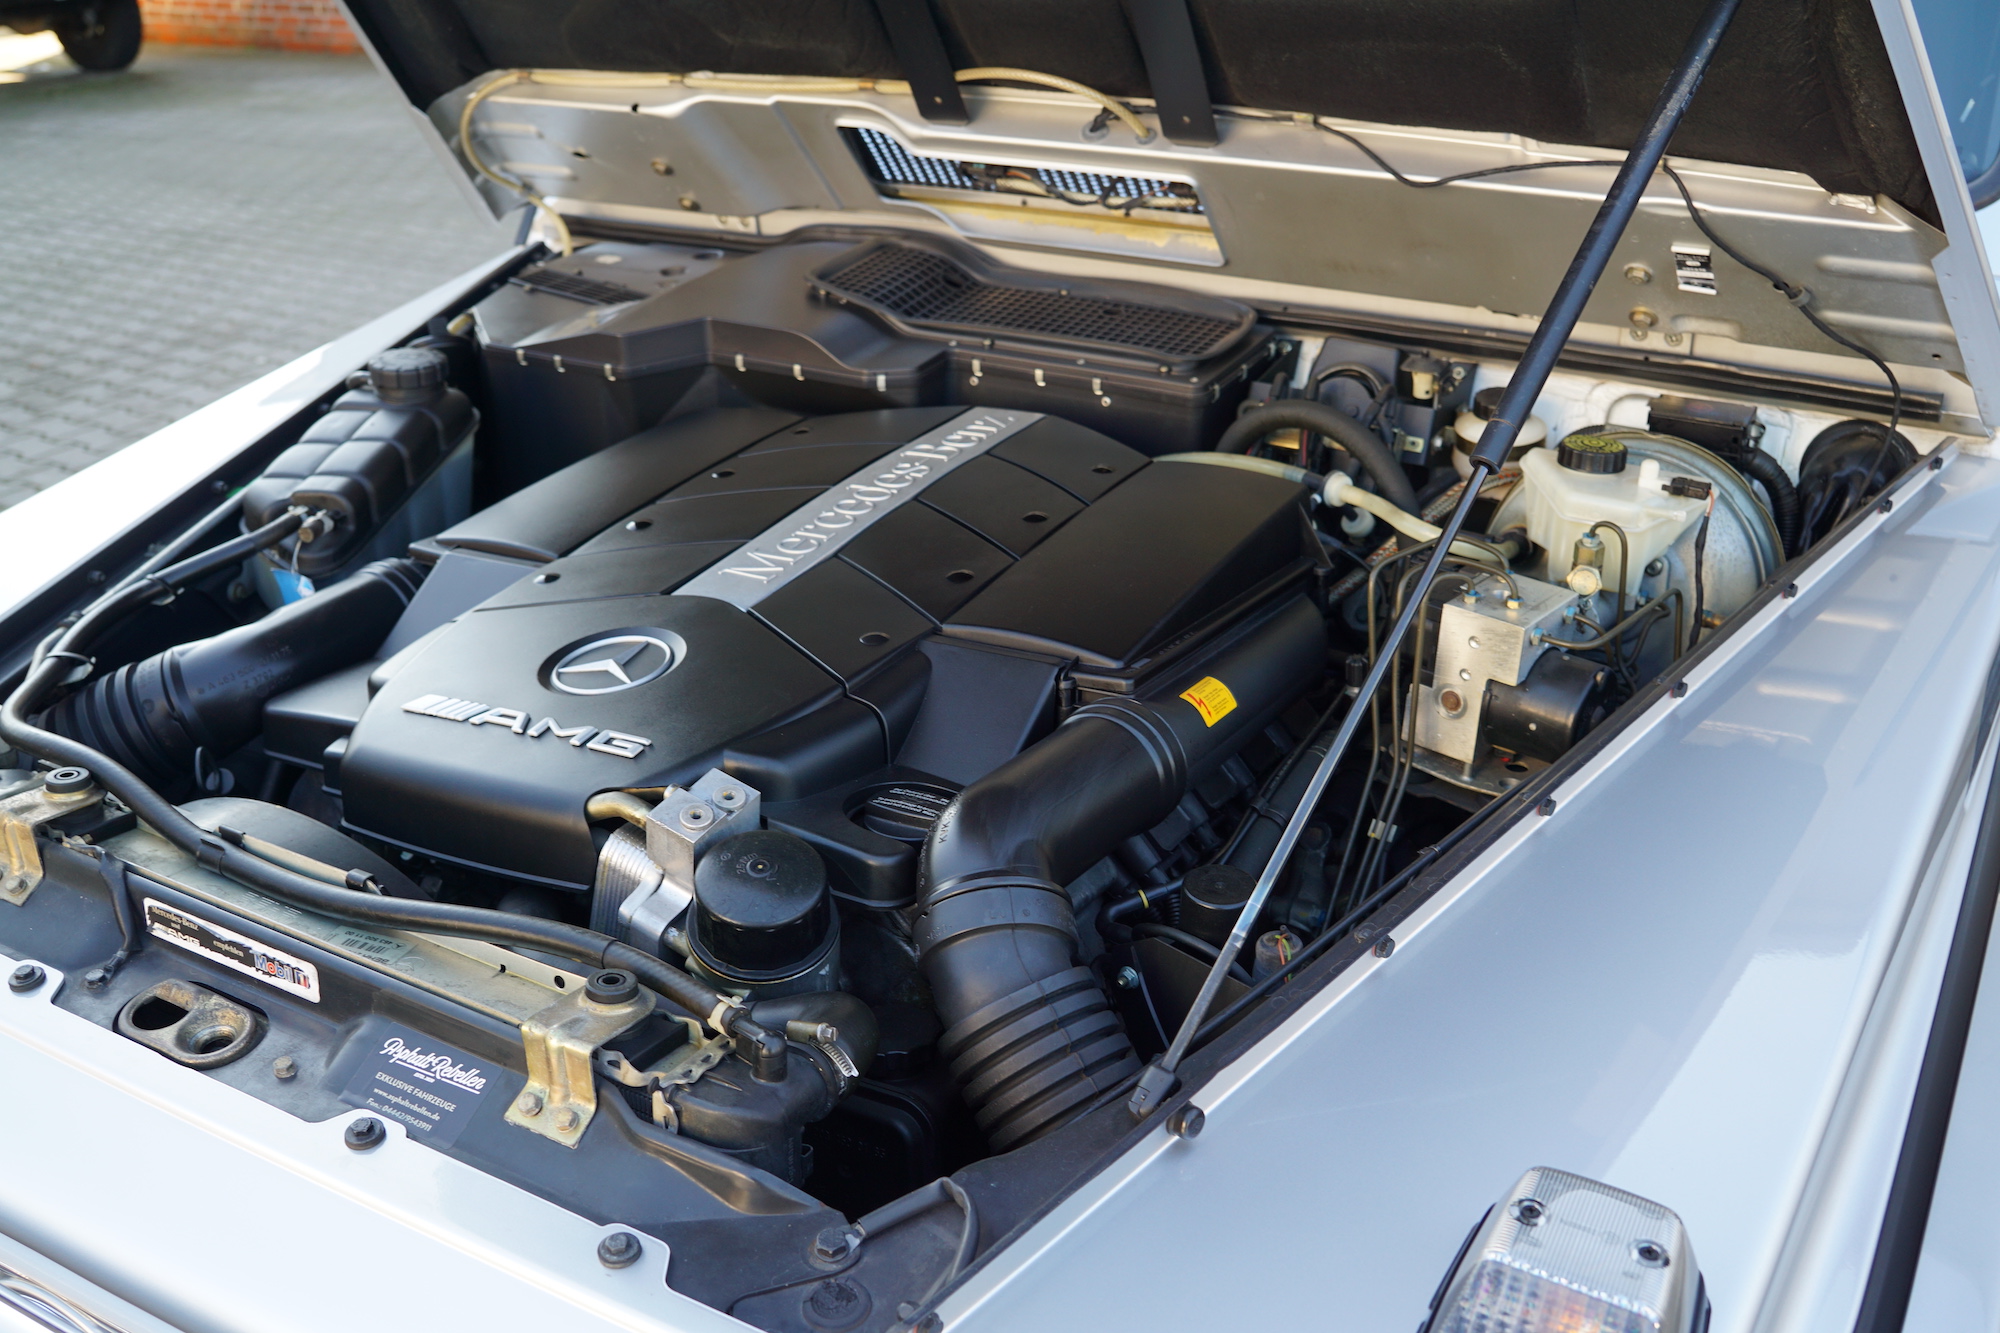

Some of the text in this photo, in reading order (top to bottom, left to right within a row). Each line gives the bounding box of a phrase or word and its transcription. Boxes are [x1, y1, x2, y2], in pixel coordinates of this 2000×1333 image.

[717, 412, 1012, 585] Mercedes-Benz
[469, 704, 653, 759] AMG
[166, 929, 201, 947] AMG
[254, 953, 293, 983] Mobil
[373, 1087, 441, 1121] www.asphaltrebellen.de
[375, 1071, 415, 1094] EXKLUSIVE
[413, 1087, 457, 1113] FAHRZEUGE
[381, 1104, 433, 1132] 04442/9543911
